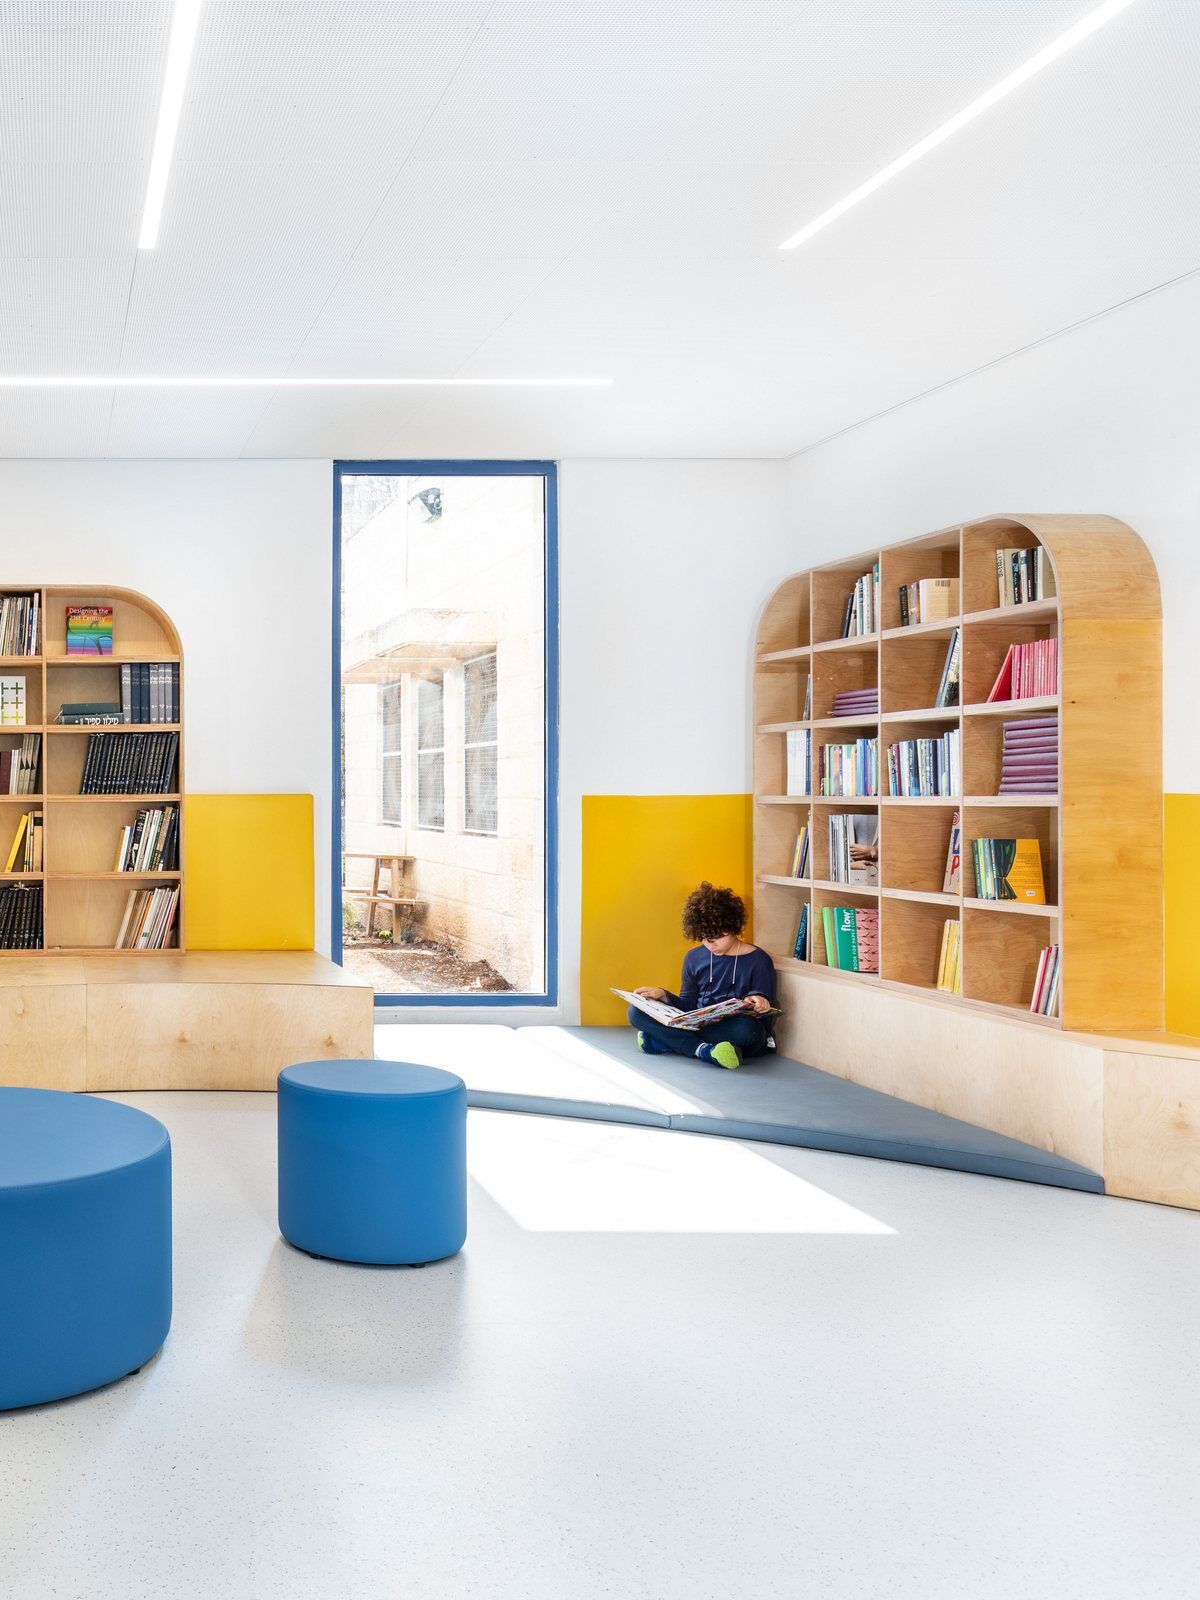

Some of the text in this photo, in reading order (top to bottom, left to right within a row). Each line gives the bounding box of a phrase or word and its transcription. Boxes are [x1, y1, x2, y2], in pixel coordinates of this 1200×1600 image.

[85, 715, 119, 726] מילון ספיר
[841, 909, 851, 931] flow
